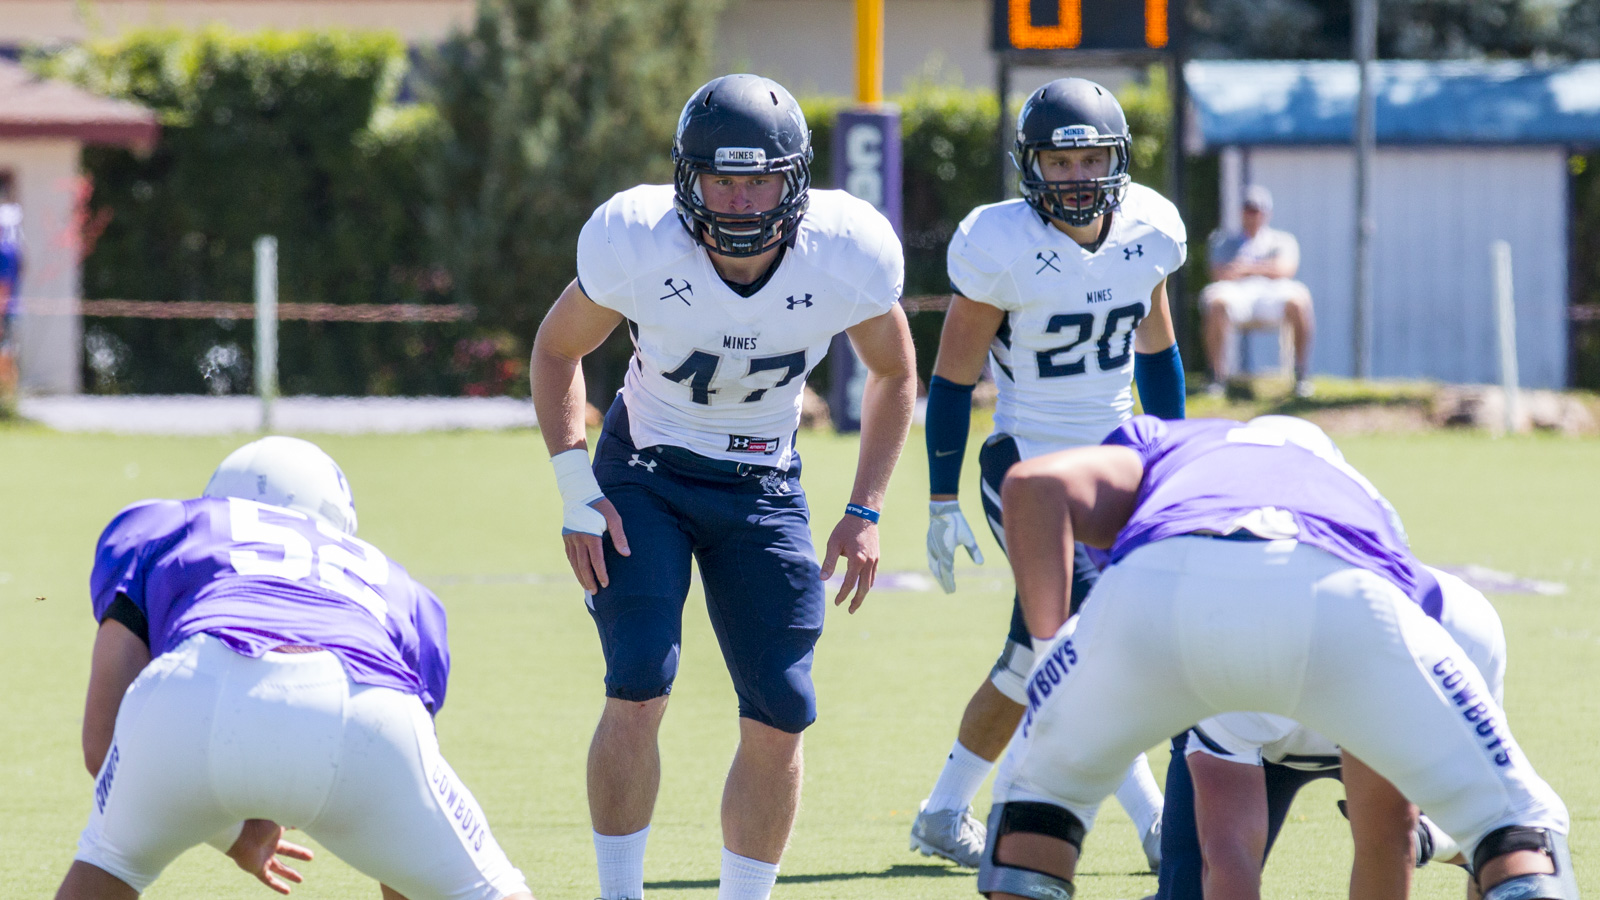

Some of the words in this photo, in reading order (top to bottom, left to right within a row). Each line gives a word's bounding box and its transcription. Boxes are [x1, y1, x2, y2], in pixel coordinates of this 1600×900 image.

[728, 150, 754, 160] MINES
[1063, 128, 1085, 136] MINES
[1086, 288, 1113, 304] MINES
[722, 334, 757, 350] MINES
[1034, 300, 1146, 379] 20
[660, 347, 808, 406] 47
[229, 497, 389, 626] 52
[1433, 656, 1515, 767] COWBOYS
[432, 764, 486, 852] COWBOYS
